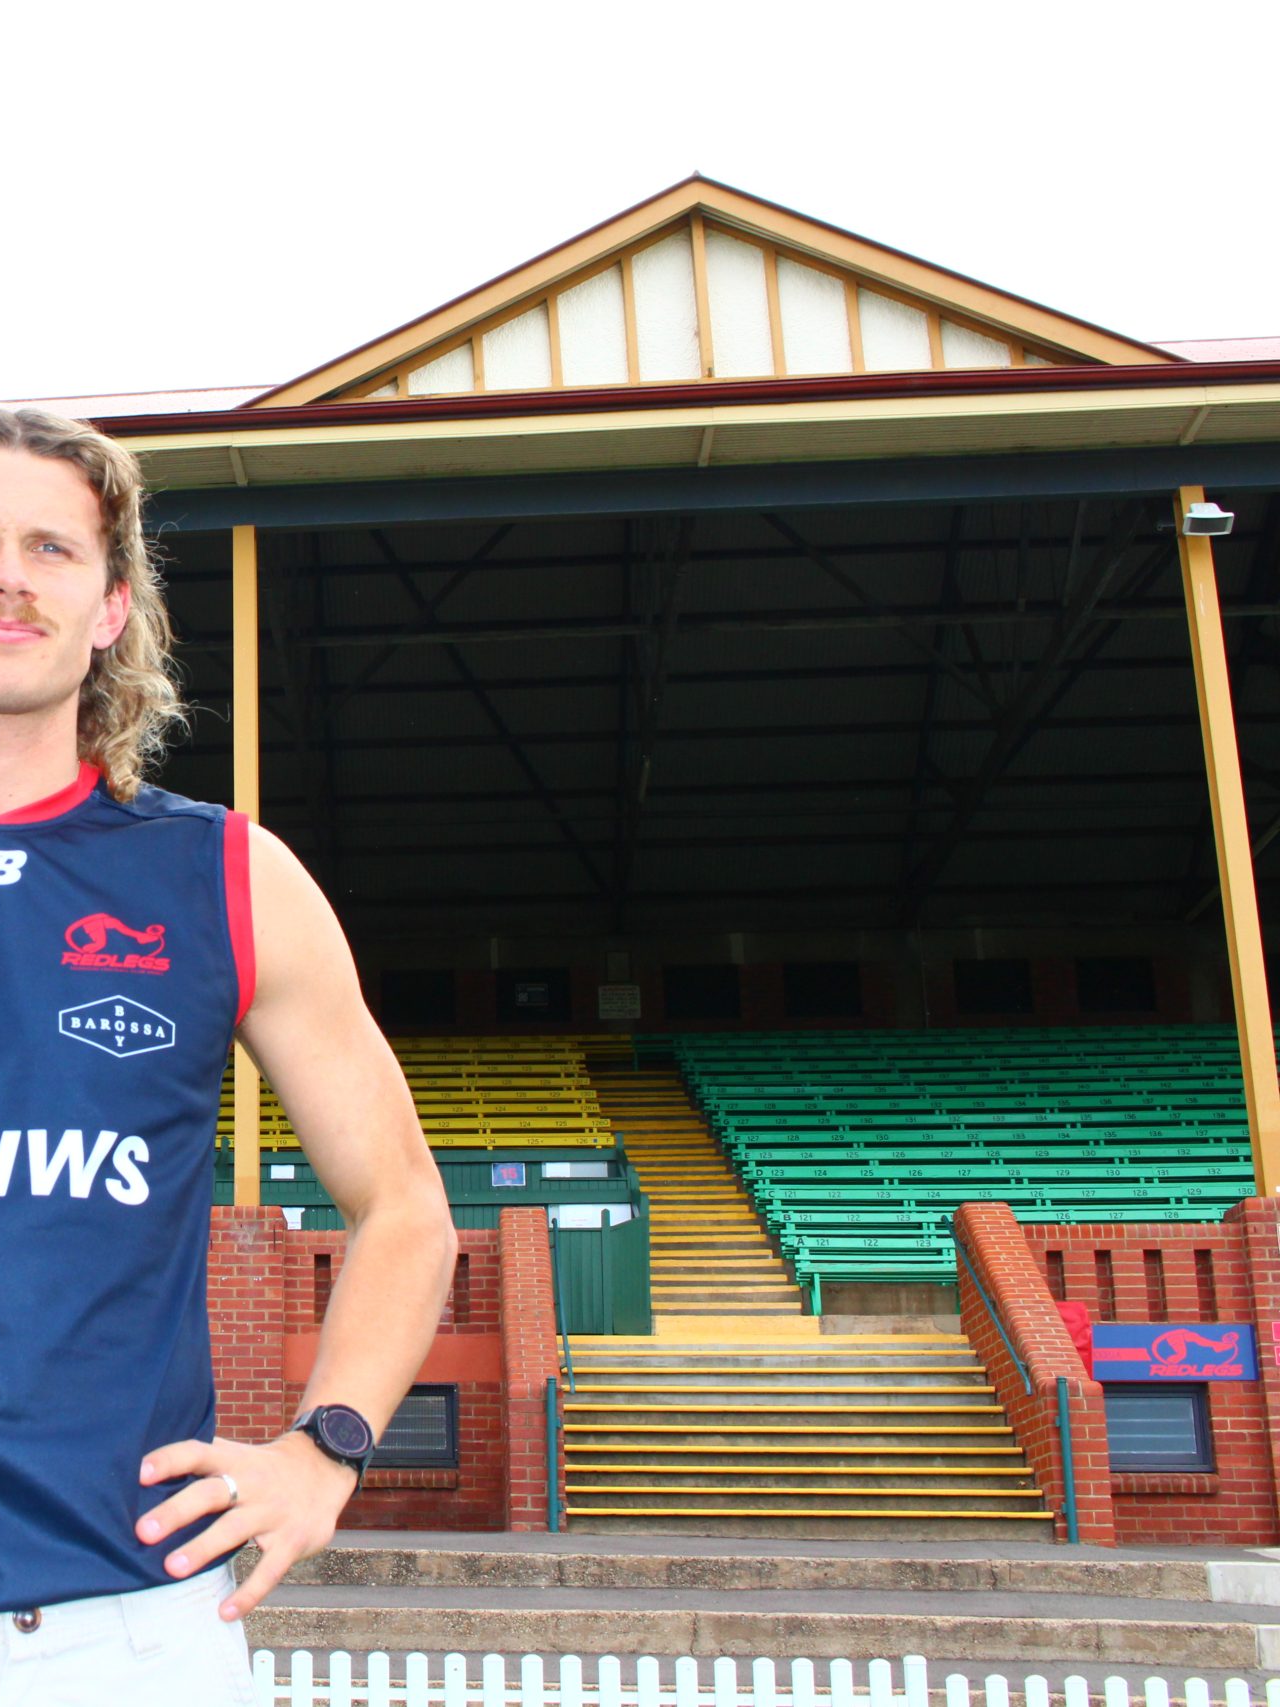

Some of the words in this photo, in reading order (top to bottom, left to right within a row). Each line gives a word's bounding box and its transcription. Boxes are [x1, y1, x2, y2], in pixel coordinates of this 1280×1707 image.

[61, 951, 171, 972] REDLEGS
[70, 1019, 166, 1039] BAROSSA
[723, 1118, 730, 1126] G
[967, 1132, 979, 1140] 132
[576, 1138, 589, 1146] 126
[846, 1150, 859, 1158] 125
[1226, 1148, 1239, 1156] 133
[768, 1190, 775, 1198] C
[784, 1190, 796, 1198] 121
[783, 1213, 791, 1221] B
[796, 1237, 805, 1246] A
[1149, 1364, 1244, 1377] REDLEGS
